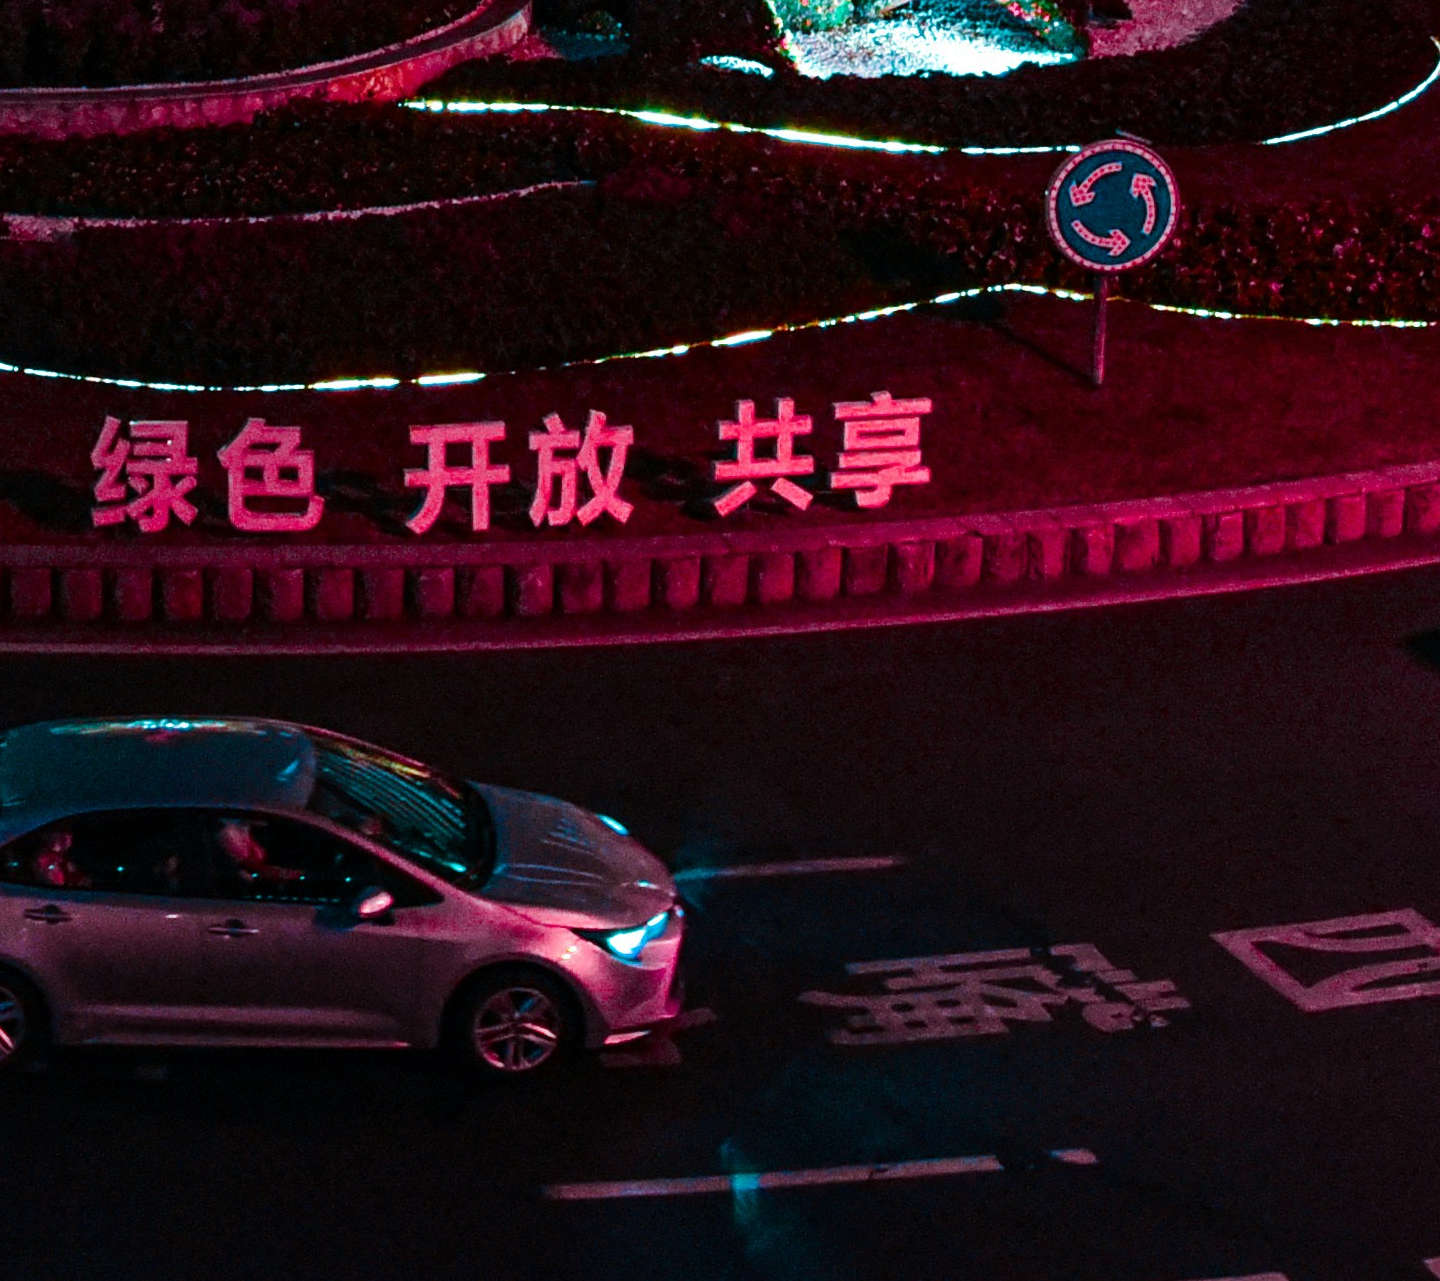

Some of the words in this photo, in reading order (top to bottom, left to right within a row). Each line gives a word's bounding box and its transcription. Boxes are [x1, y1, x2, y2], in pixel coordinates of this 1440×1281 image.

[90, 414, 326, 535] 绿色
[403, 407, 637, 536] 开放
[711, 389, 936, 519] 共享
